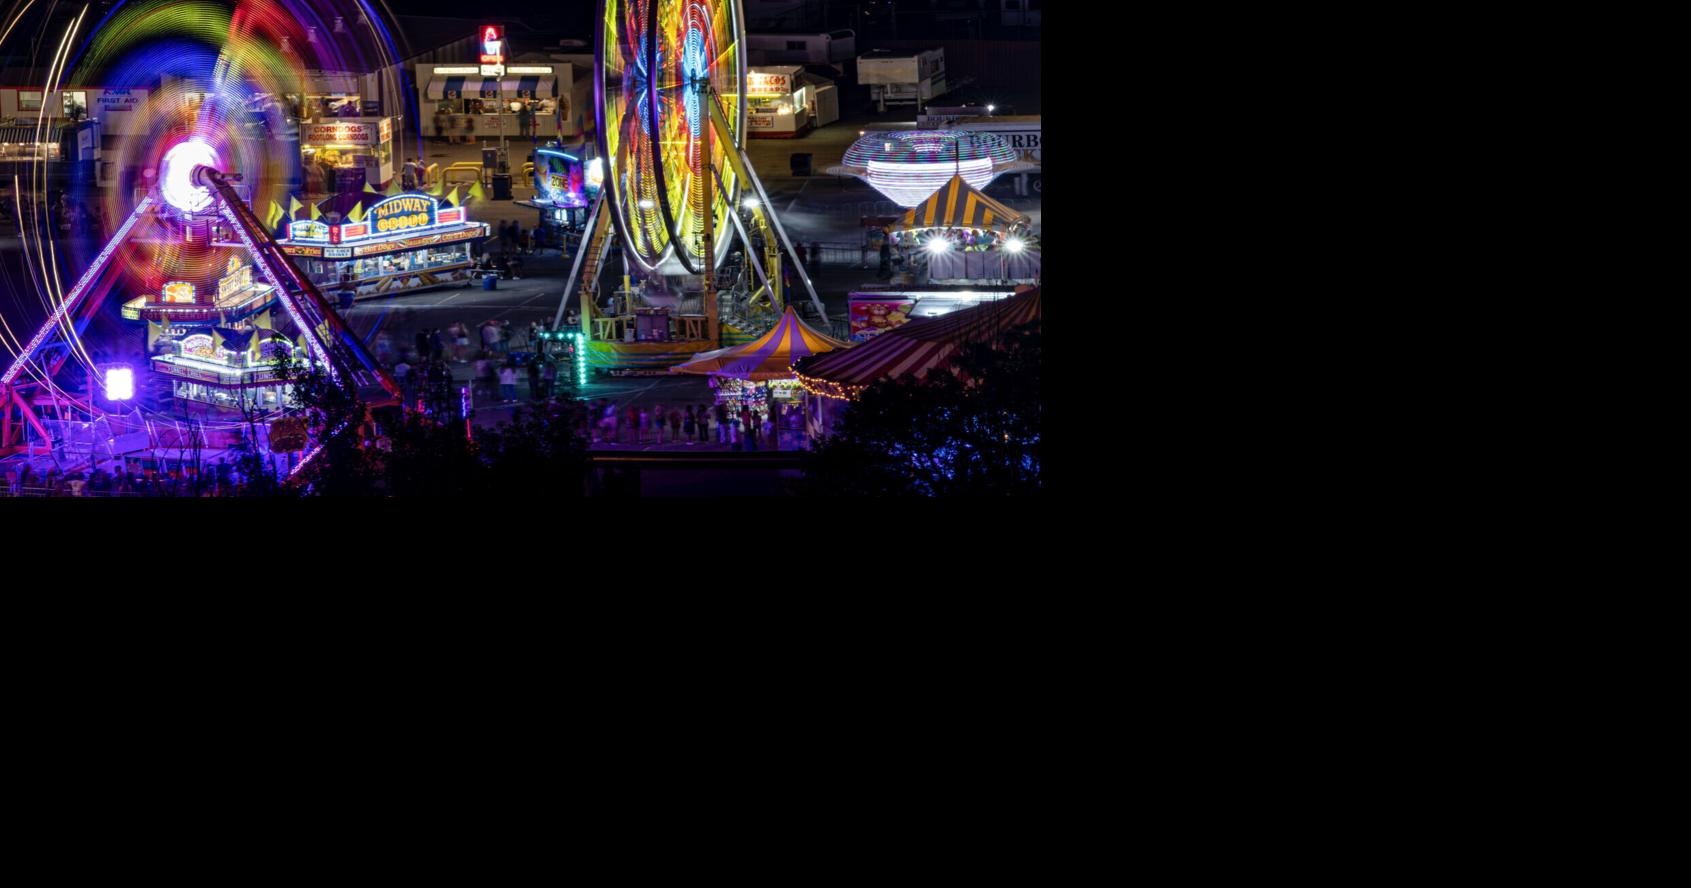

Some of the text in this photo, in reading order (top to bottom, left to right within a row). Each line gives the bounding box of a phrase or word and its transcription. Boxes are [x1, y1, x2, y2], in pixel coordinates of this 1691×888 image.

[969, 134, 1041, 148] BOURB
[551, 175, 568, 189] ZONE
[374, 198, 431, 218] MIDWAY
[377, 212, 429, 231] GRILL
